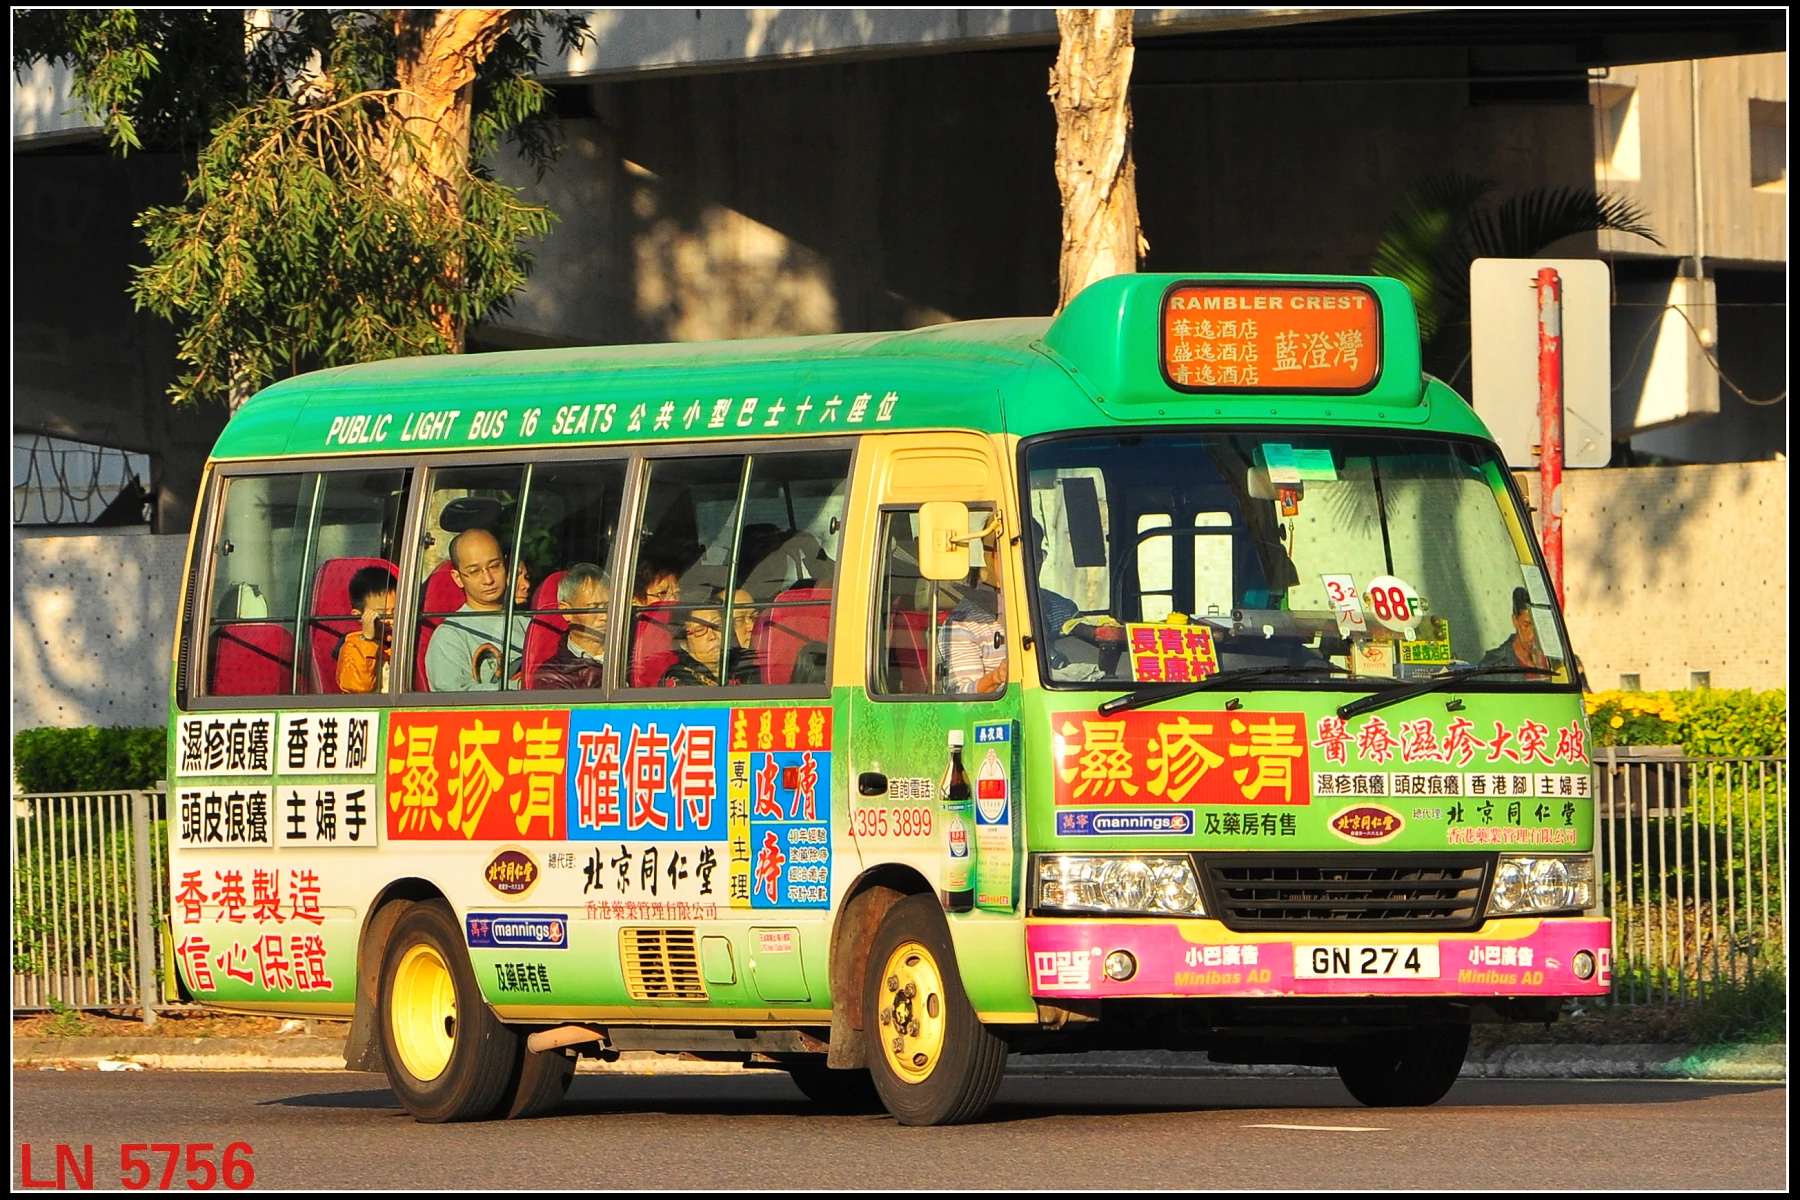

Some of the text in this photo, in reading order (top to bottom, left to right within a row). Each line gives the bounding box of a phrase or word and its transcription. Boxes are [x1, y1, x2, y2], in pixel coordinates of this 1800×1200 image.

[1170, 295, 1367, 310] RAMBLER CREST
[1171, 318, 1259, 341] 華逸酒店
[1171, 342, 1260, 364] 盛逸酒店
[1272, 328, 1364, 371] 藍澄灣
[1171, 364, 1260, 386] 青逸酒店
[325, 391, 899, 446] PUBLIC LIGHT BUS 16 SEATS 公共小型巴士十六座位
[1340, 603, 1363, 625] 元
[1132, 627, 1211, 655] 長青村
[181, 717, 270, 772] 濕疹痕癢
[287, 716, 369, 770] 香港腳
[1312, 715, 1591, 766] 醫療濕疹大突破
[1059, 716, 1304, 802] 濕疹清
[388, 717, 566, 840] 濕疹清
[575, 723, 717, 831] 確使得
[1317, 774, 1385, 795] 濕疹痕癢
[1394, 774, 1460, 795] 頭皮痕癢
[1471, 775, 1528, 795] 香港腳
[1540, 775, 1588, 796] 主婦手
[181, 790, 269, 843] 頭皮痕癢
[286, 789, 367, 842] 主婦手
[893, 808, 932, 837] 3899
[1097, 816, 1170, 830] mannings
[1203, 812, 1297, 837] 及藥房有售
[1337, 815, 1394, 831] 北京同仁堂
[1446, 800, 1576, 827] 北京同仁堂
[1447, 827, 1577, 845] 香港藥業管理有限公司
[488, 860, 533, 882] 北京同仁堂
[583, 844, 718, 897] 北京同仁堂
[175, 868, 326, 926] 香港製造
[584, 900, 719, 921] 香港藥業管理有限公司
[494, 921, 550, 941] mannings
[177, 934, 333, 992] 信心保證
[1185, 945, 1259, 967] 小巴廣告
[1312, 947, 1421, 975] GN 274
[1468, 945, 1534, 967] 小巴廣告
[494, 962, 552, 994] 及藥房有售
[1247, 968, 1273, 984] AD
[1458, 969, 1544, 986] Minibus AD
